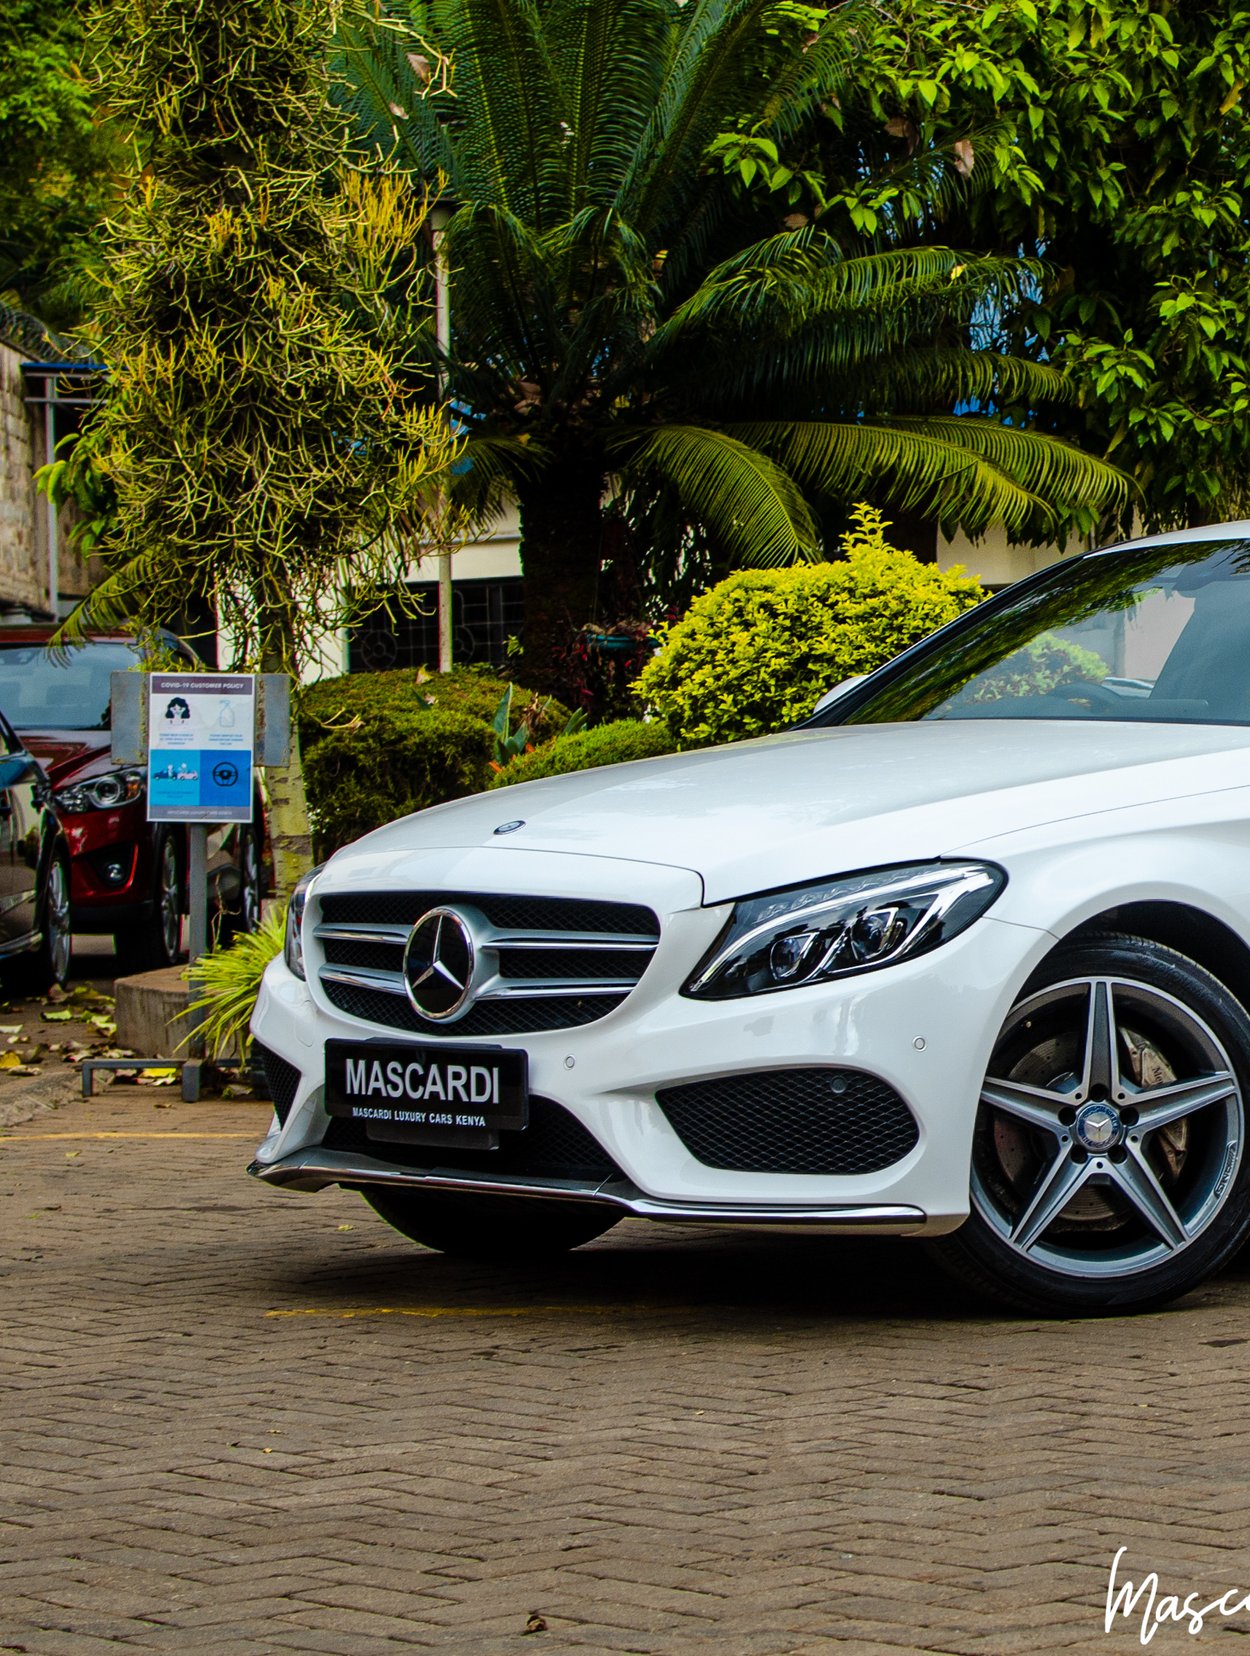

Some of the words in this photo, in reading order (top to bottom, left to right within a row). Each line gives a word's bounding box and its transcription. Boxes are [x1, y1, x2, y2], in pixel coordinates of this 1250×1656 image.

[160, 681, 189, 689] COVID-19
[346, 1058, 499, 1104] MASCARDI
[352, 1107, 392, 1120] MASCARDI
[394, 1110, 426, 1122] LUXURY
[429, 1112, 453, 1125] CARS
[455, 1114, 486, 1127] KENYA
